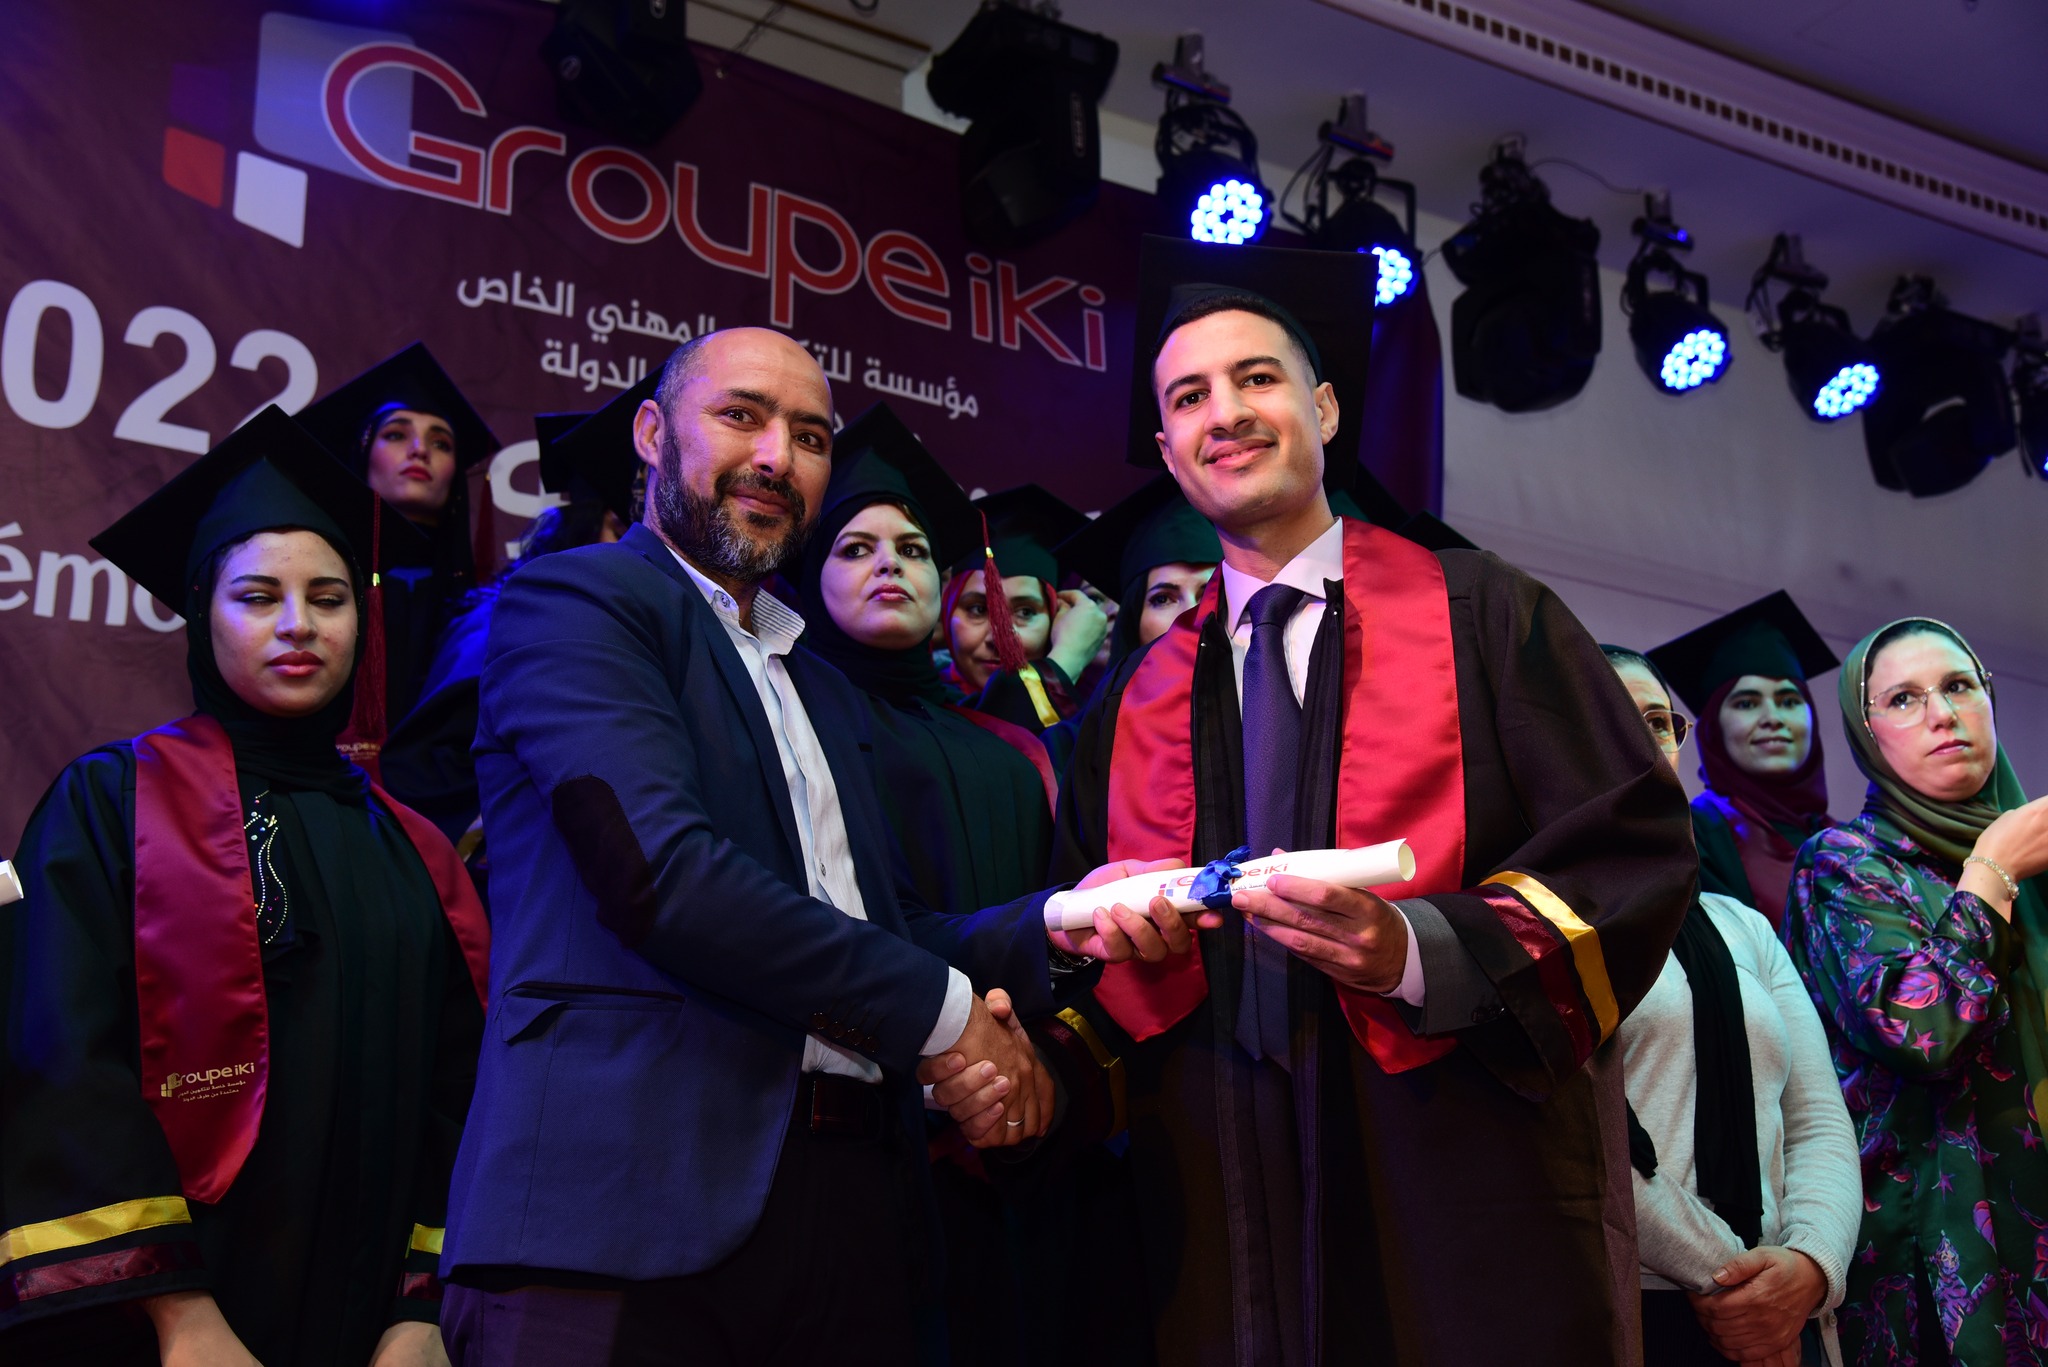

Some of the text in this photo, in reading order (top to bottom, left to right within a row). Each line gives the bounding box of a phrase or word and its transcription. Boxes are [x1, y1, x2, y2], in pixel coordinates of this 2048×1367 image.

[322, 41, 1106, 372] Groupe iKi
[457, 271, 575, 318] الخاص
[541, 339, 647, 392] الدولة
[863, 357, 979, 419] مؤسسة
[169, 1066, 233, 1088] Groupe
